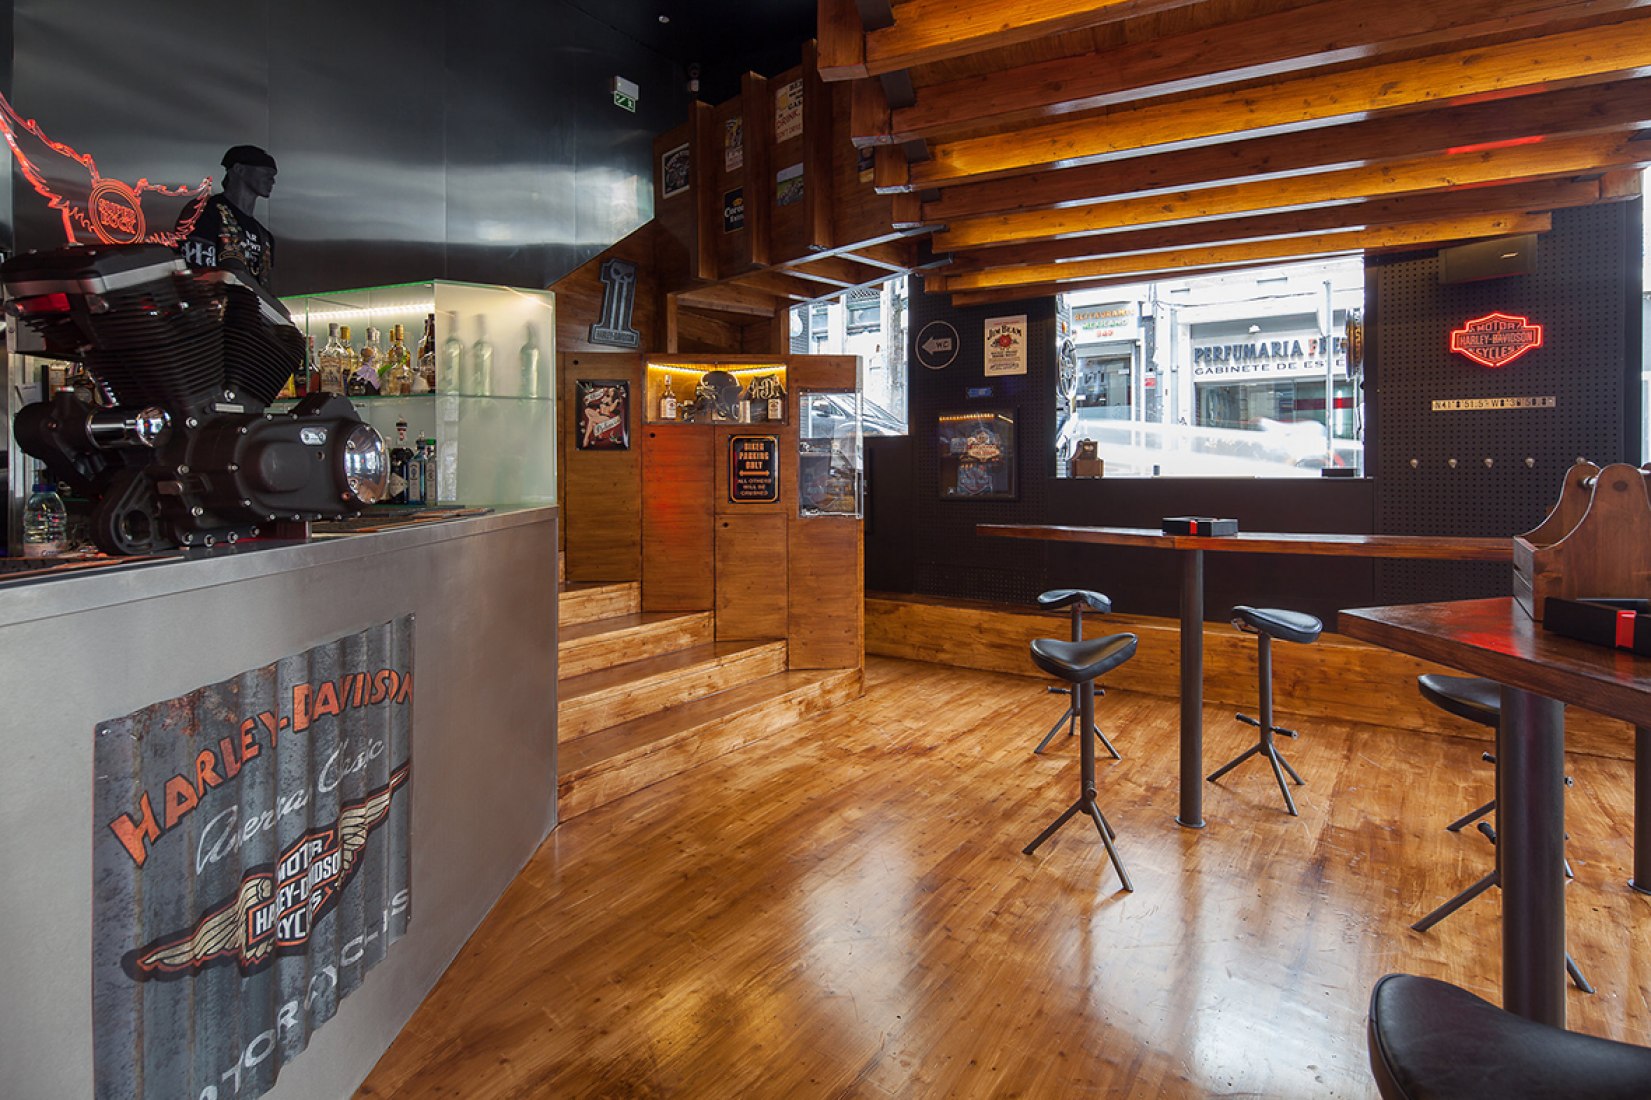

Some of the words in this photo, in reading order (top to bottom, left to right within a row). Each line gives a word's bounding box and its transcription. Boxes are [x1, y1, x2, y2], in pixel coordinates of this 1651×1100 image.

[1001, 325, 1022, 336] BEAM
[1477, 321, 1516, 332] MOTOR
[1459, 332, 1533, 345] HARLEY-DAVIDSON
[936, 340, 949, 349] WC
[1194, 339, 1304, 363] PERFUMARIA
[1195, 363, 1270, 375] GABINETE
[1277, 361, 1297, 370] DE
[744, 442, 764, 451] BIKER
[739, 451, 769, 460] PARKING
[745, 461, 763, 469] ONLY
